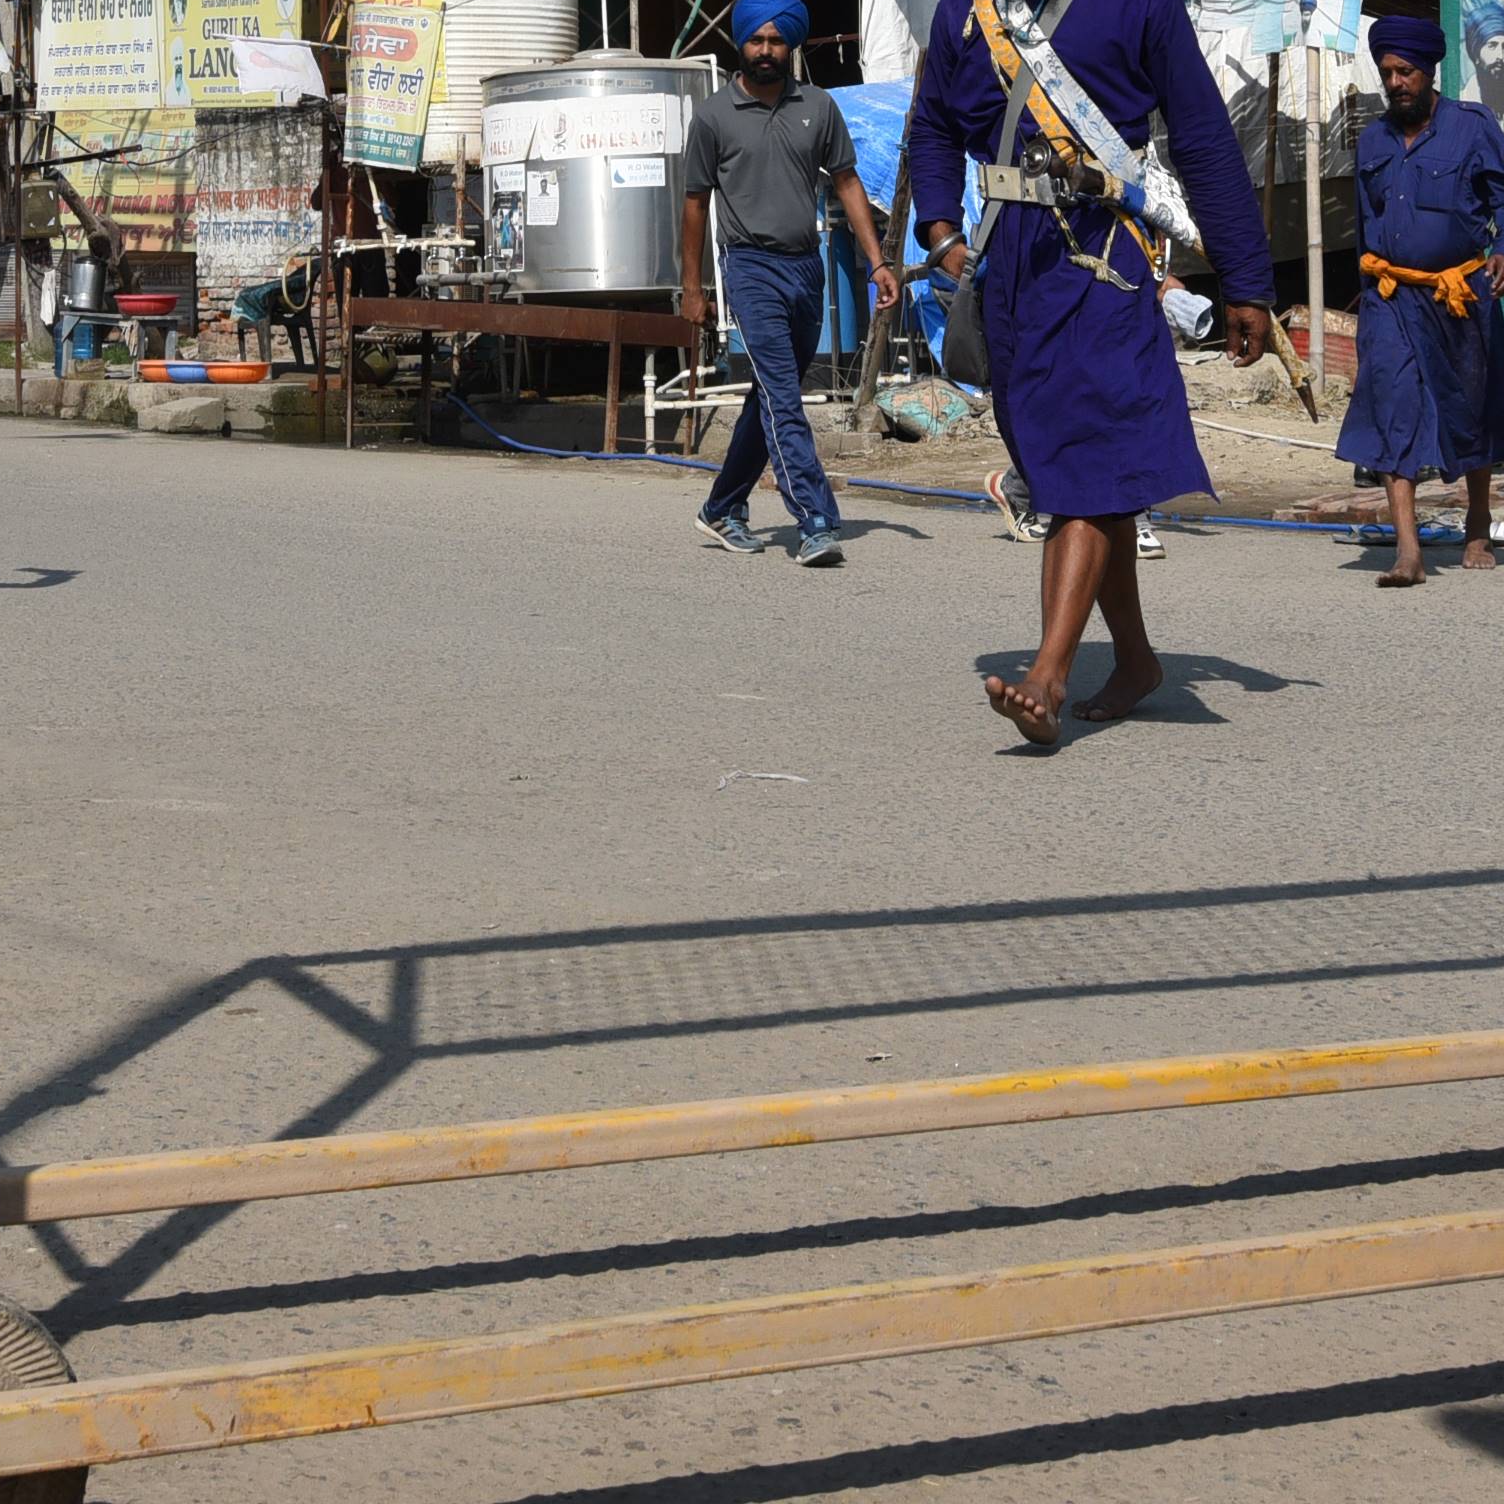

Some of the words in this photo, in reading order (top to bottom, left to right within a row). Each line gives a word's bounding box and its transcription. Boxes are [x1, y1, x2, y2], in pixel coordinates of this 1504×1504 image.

[202, 17, 238, 40] GURU
[242, 16, 261, 38] KA
[363, 27, 408, 55] ਸੇਵਾ
[368, 62, 395, 91] ਵੀਰਾਂ
[398, 68, 424, 95] ਲਈ
